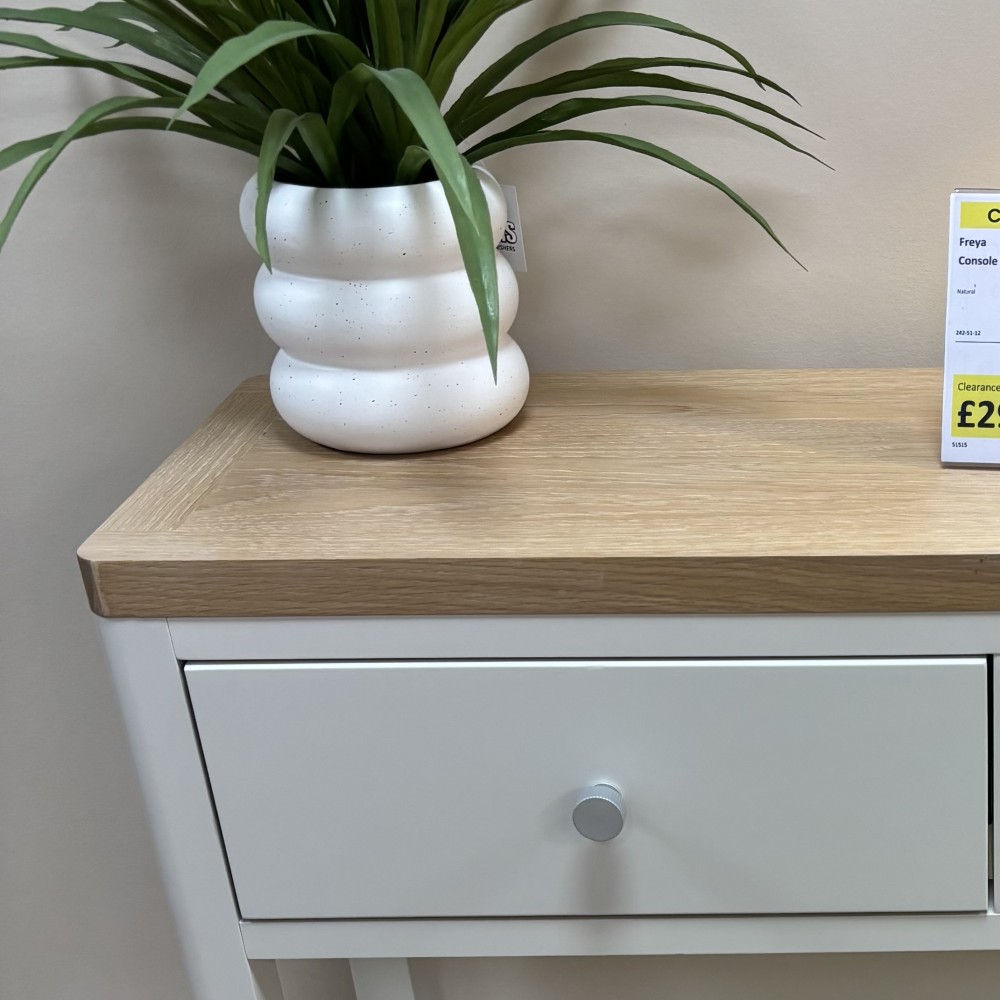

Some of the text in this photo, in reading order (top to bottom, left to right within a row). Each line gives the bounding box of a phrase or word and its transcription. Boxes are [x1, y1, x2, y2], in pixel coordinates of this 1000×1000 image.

[959, 237, 987, 248] Freya
[958, 256, 998, 266] Console
[957, 382, 1000, 392] Clearance
